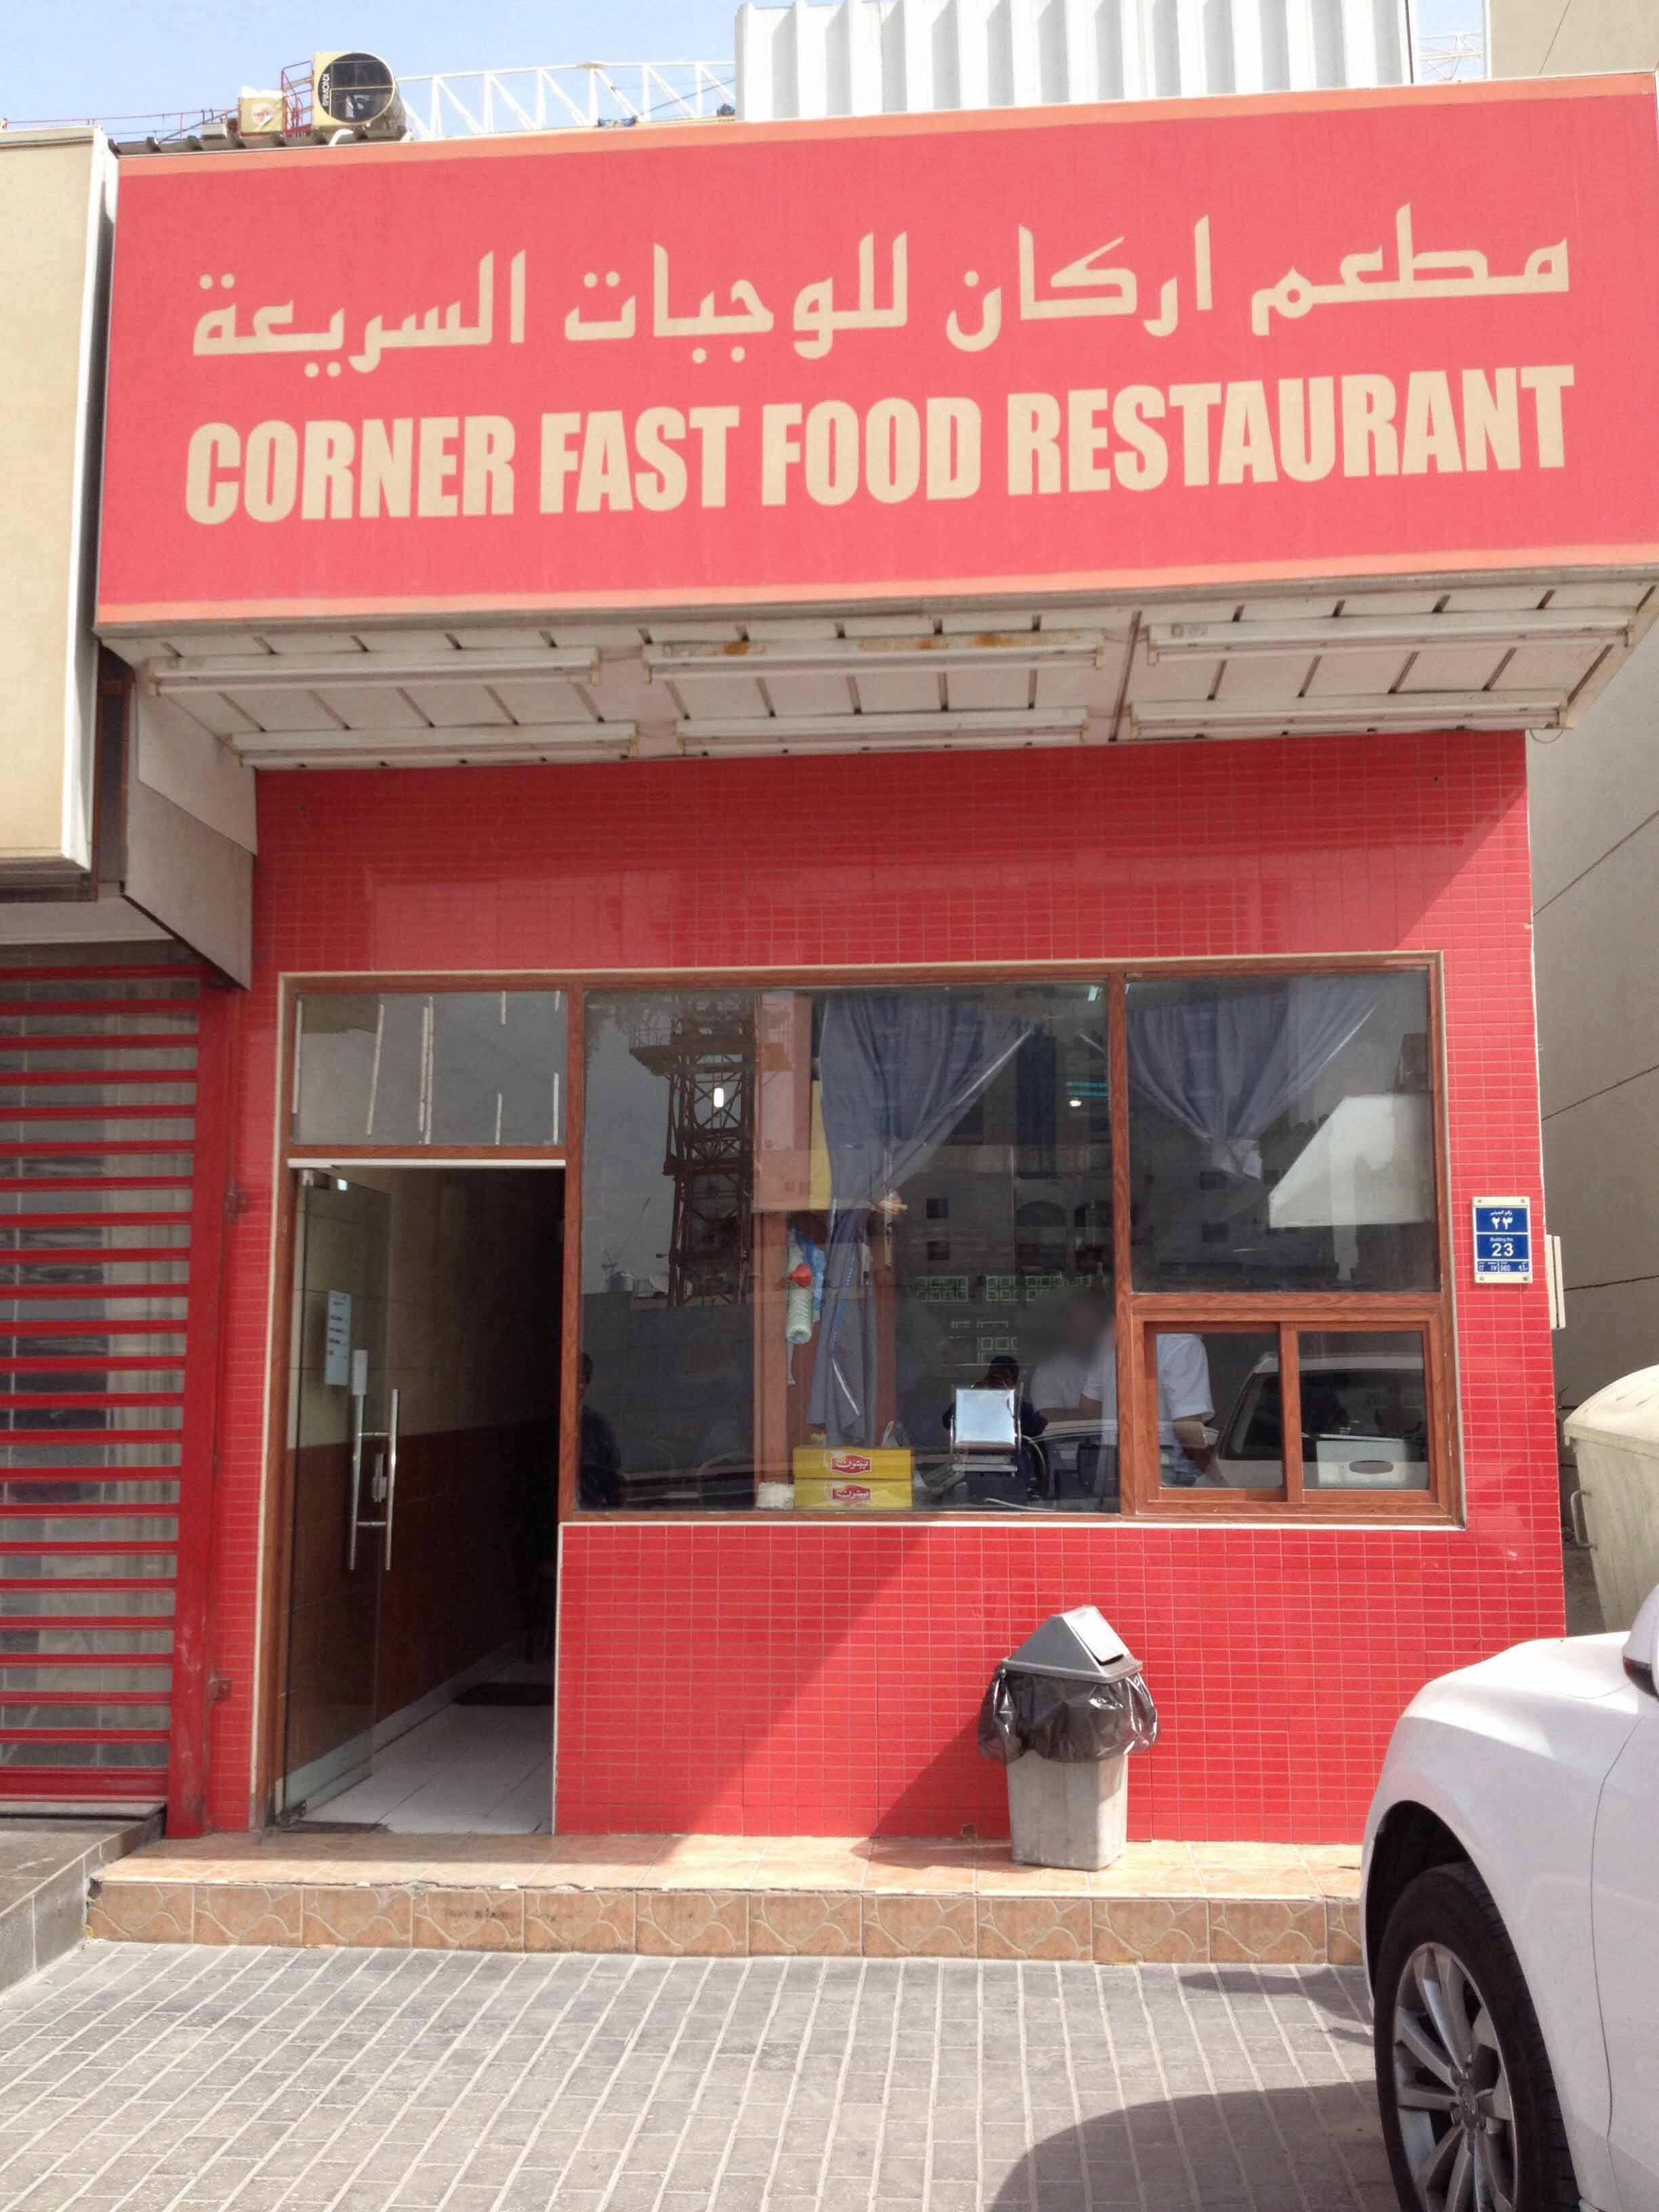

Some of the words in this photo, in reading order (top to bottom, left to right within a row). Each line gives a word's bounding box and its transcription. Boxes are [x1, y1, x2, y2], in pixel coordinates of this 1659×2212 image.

[192, 250, 526, 379] السريعة
[564, 231, 909, 365] للوجبات
[945, 214, 1213, 352] اركان
[1250, 203, 1570, 337] مطعم
[185, 415, 516, 525] CORNER
[539, 405, 741, 514] FAST
[761, 396, 983, 507] FOOD
[1006, 364, 1575, 497] RESTAURANT
[1492, 1217, 1513, 1230] ٢٣
[1492, 1242, 1513, 1257] 23
